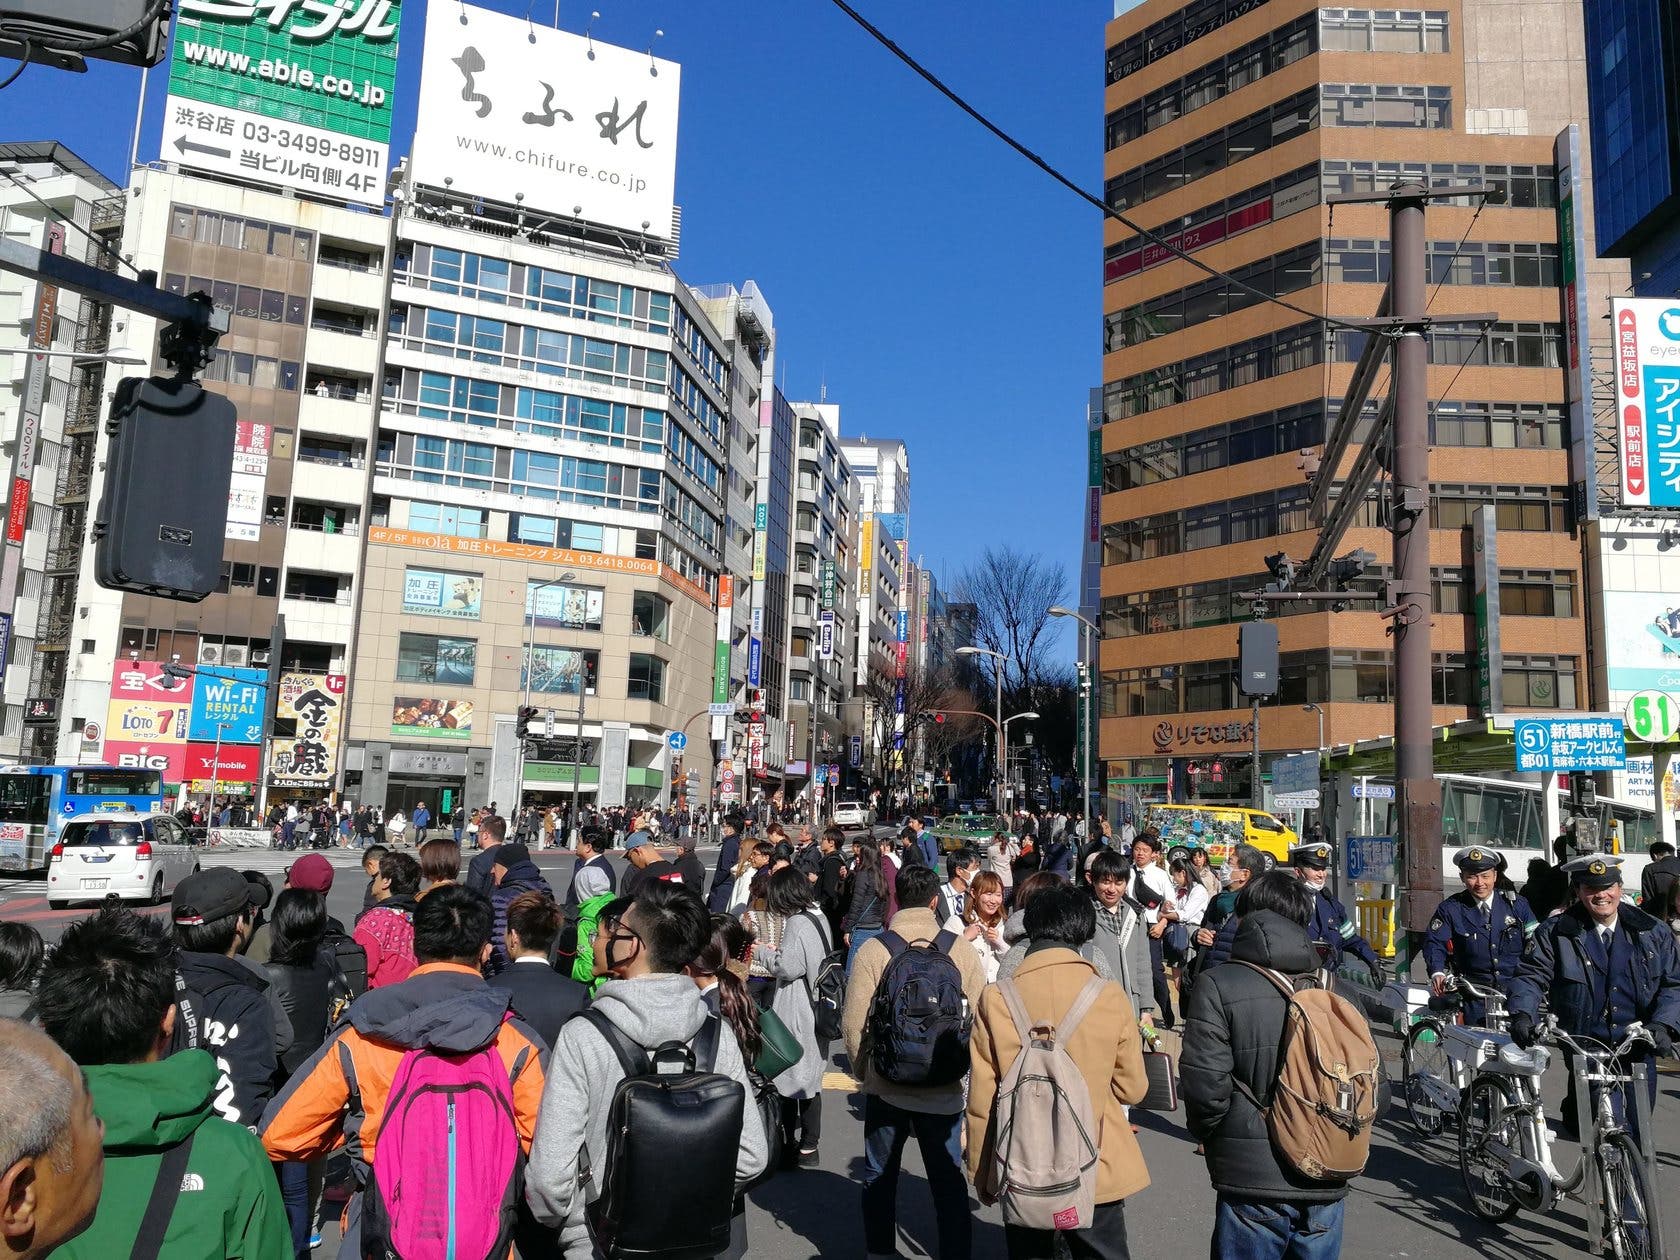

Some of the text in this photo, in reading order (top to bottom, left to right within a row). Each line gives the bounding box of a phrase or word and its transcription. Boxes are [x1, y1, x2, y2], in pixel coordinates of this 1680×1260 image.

[184, 40, 385, 106] www.able.co.jp
[451, 46, 653, 148] ちふれ
[175, 106, 380, 168] 渋谷店 03-3499-8911
[456, 135, 647, 193] www.chifure.co.jp
[345, 172, 377, 193] 4F
[1622, 331, 1638, 387] 宮益坂店
[1650, 345, 1680, 358] eye
[1626, 426, 1642, 468] 駅前店
[757, 506, 766, 528] NOVA
[579, 554, 653, 571] 03.6418.0064
[329, 677, 344, 689] 1F
[205, 685, 257, 704] Wi-Fi
[205, 712, 239, 721] レンタル
[206, 703, 255, 714] RENTAL
[1633, 695, 1669, 737] 51
[122, 714, 152, 729] LOTO
[157, 709, 173, 734] 7
[247, 726, 260, 735] 2F
[1523, 729, 1544, 748] 51
[118, 754, 169, 771] BIG
[1521, 754, 1549, 768] 都01
[1627, 760, 1654, 774] 画材
[180, 999, 197, 1049] SUPRE
